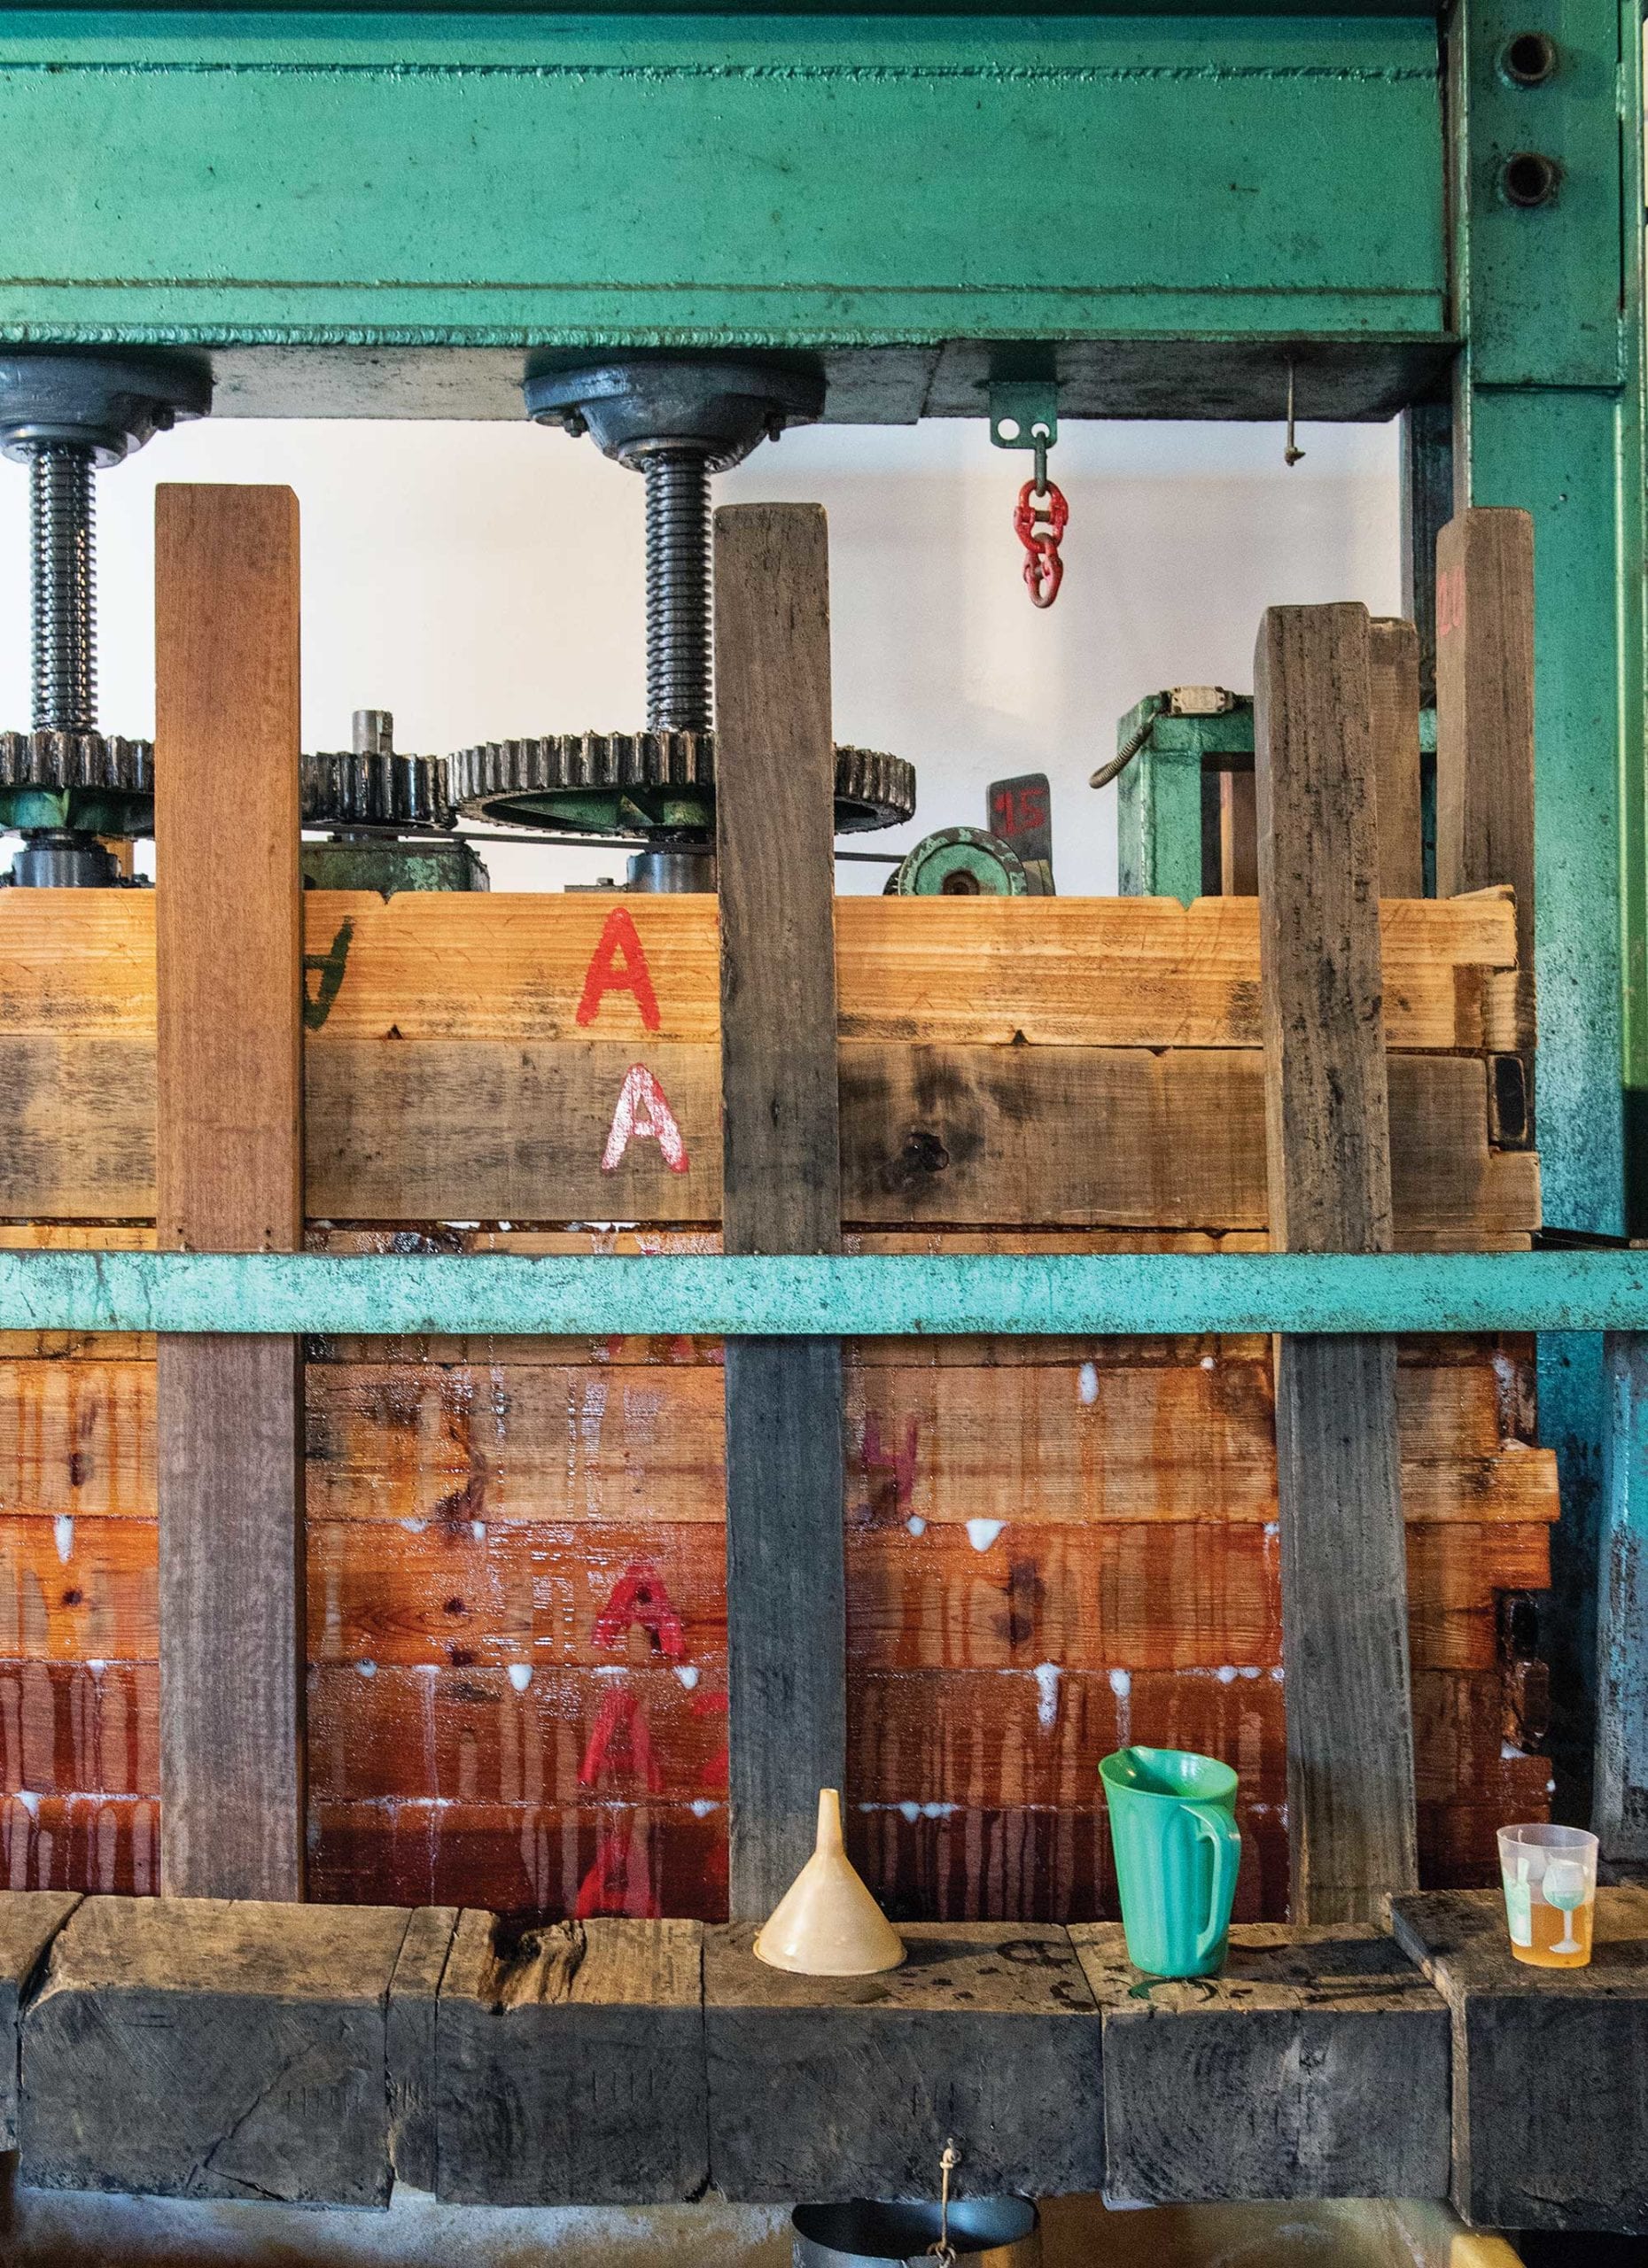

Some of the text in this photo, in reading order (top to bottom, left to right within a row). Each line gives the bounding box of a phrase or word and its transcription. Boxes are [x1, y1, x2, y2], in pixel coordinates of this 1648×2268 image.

[993, 788, 1046, 837] 15
[576, 906, 661, 1031] A
[601, 1062, 690, 1174] A
[591, 1561, 688, 1663] A
